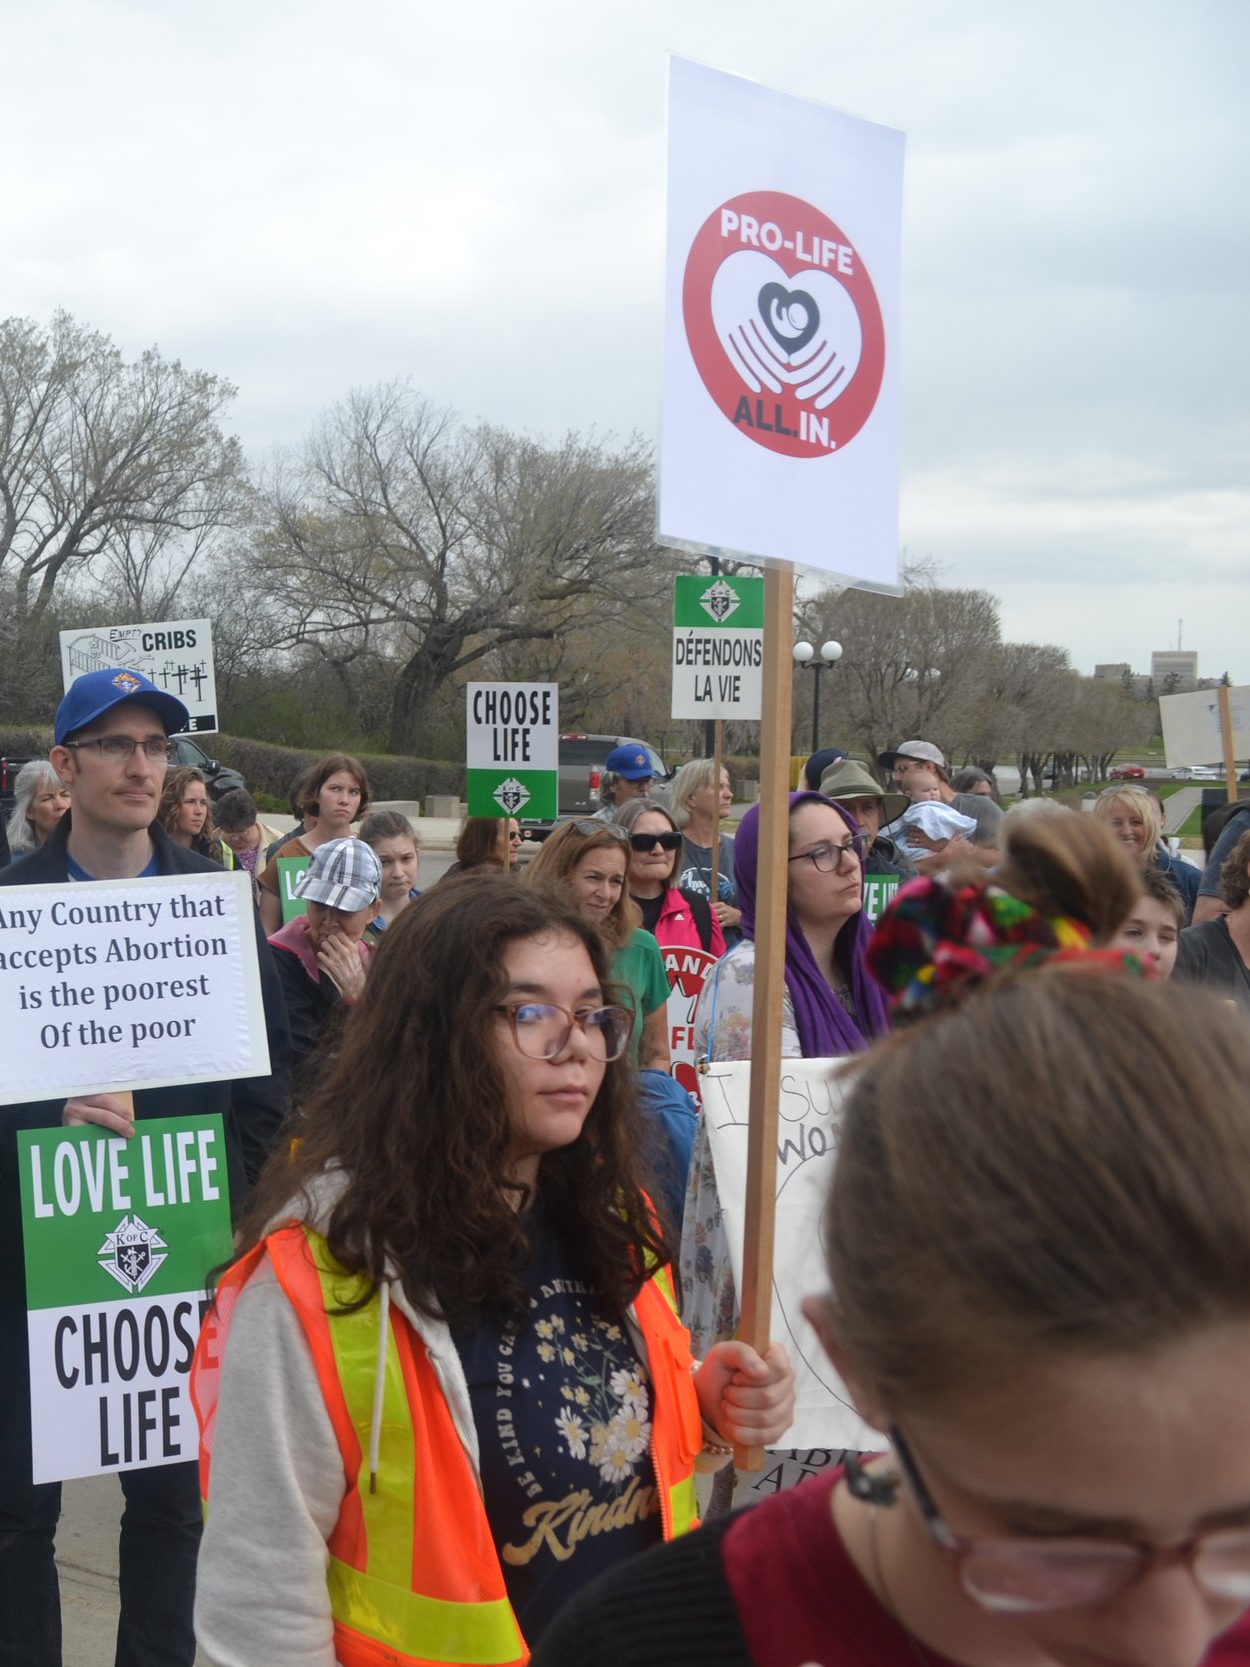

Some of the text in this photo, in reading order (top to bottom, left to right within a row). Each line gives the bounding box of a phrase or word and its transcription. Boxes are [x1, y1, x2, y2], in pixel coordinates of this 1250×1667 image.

[721, 208, 854, 276] PRO-LIFE
[142, 629, 197, 652] CRIBS
[675, 630, 762, 667] DÉFENDONS
[694, 675, 741, 702] LA VIE
[473, 690, 551, 725] CHOOSE
[493, 728, 530, 761] LIFE
[51, 902, 162, 926] Country
[170, 894, 226, 919] that
[105, 934, 228, 963] Abortion
[19, 974, 210, 1010] is the poorest
[40, 1018, 196, 1049] Of the poor
[30, 1129, 219, 1218] LOVE LIFE
[116, 1231, 148, 1246] K OF C
[497, 1362, 514, 1397] YOU
[99, 1387, 181, 1467] LIFE
[497, 1408, 525, 1466] KIND
[517, 1471, 543, 1498] BE
